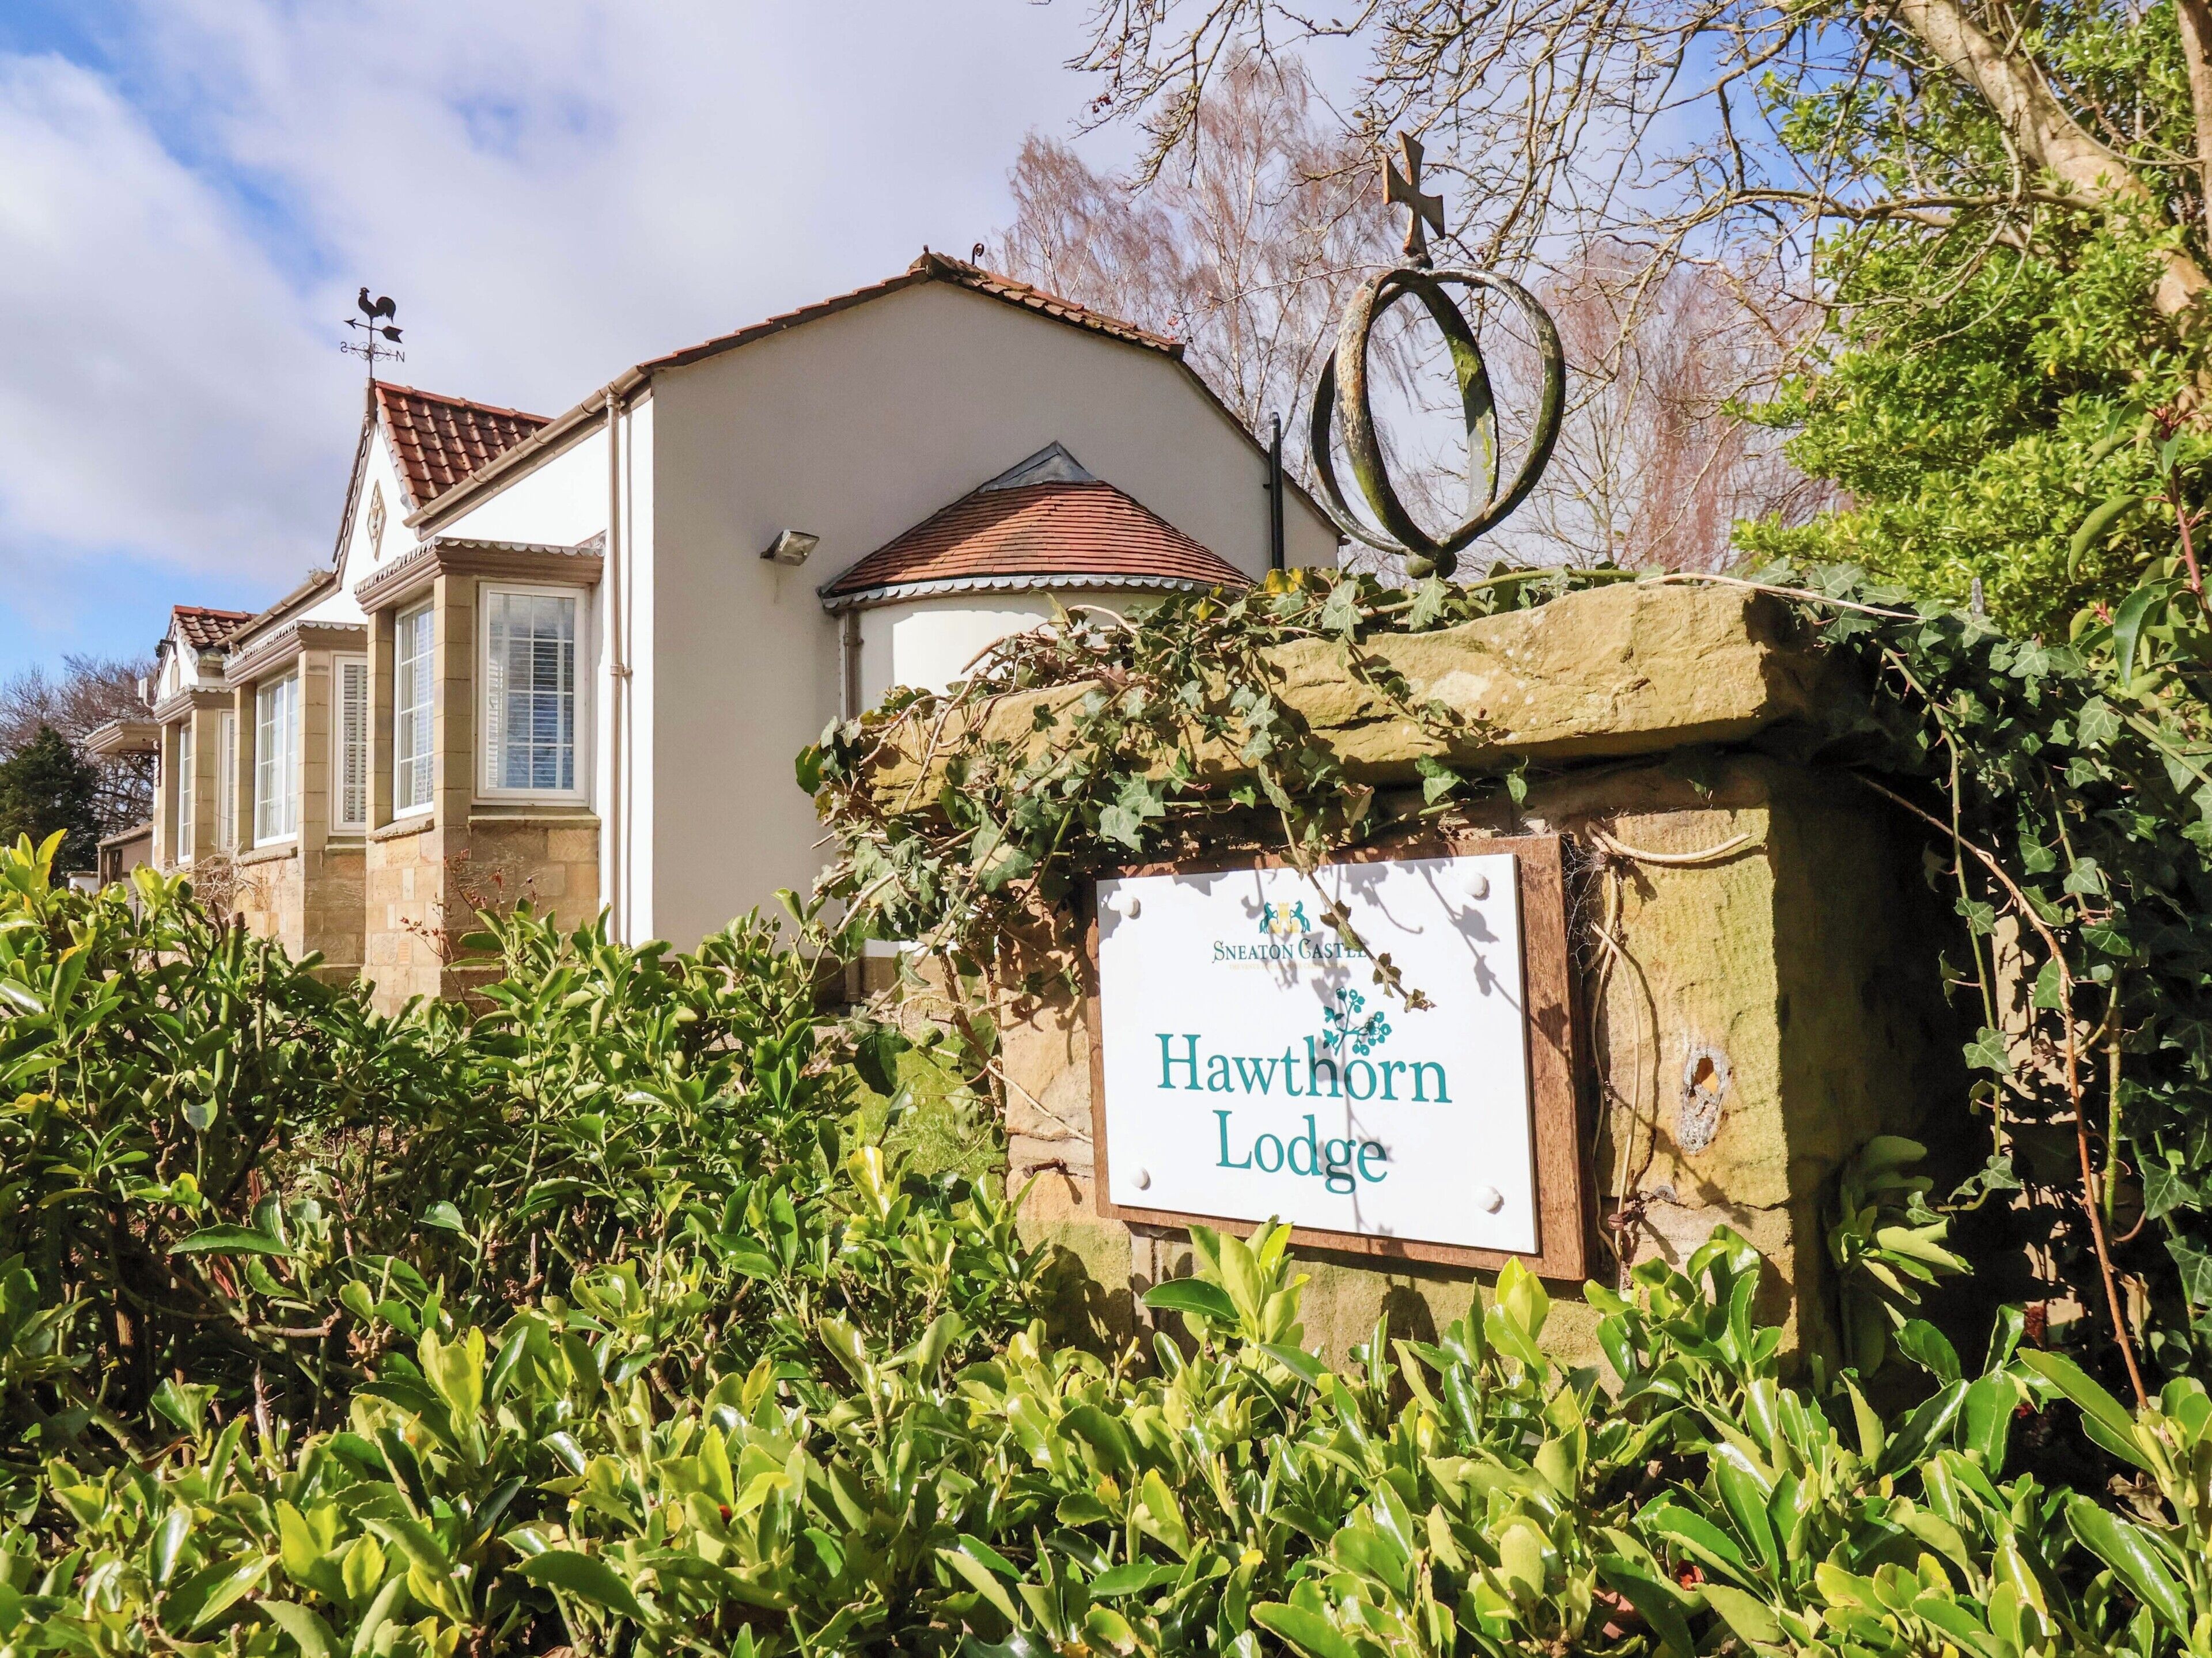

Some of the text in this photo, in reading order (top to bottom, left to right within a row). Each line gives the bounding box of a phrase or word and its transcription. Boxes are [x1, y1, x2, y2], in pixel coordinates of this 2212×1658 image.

[396, 350, 404, 362] N
[1213, 940, 1293, 963] SNEATON
[1156, 1033, 1452, 1104] Hawthorn
[1213, 1110, 1388, 1195] Lodge
